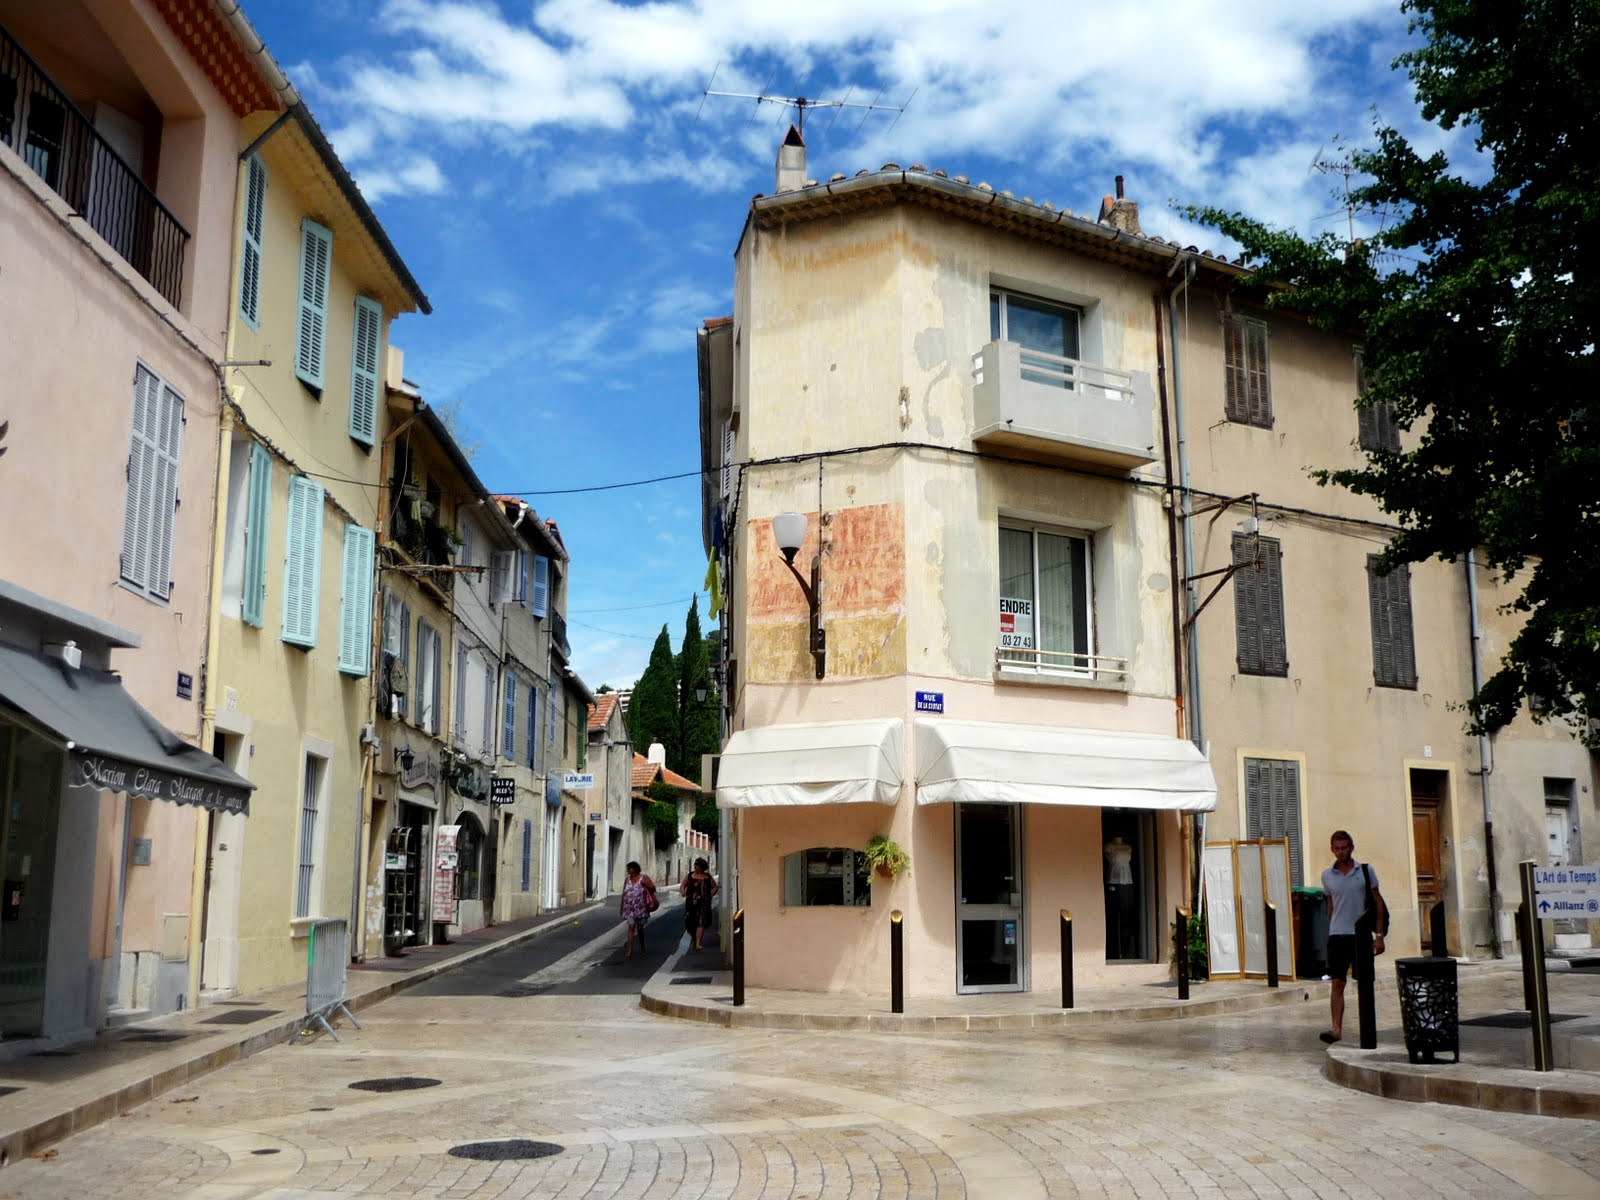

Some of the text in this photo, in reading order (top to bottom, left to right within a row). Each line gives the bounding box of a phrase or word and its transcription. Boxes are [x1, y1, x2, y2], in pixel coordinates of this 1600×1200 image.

[1002, 634, 1031, 648] 03 27 43
[923, 693, 936, 702] RUE
[82, 757, 125, 787] Marion
[134, 767, 162, 794] Clara
[170, 776, 204, 806] Margot
[565, 775, 592, 783] LAVRIE
[492, 780, 514, 788] SALON
[491, 795, 514, 803] MARINE
[1536, 870, 1597, 885] L'Art du Temps
[1553, 901, 1585, 911] Allianz
